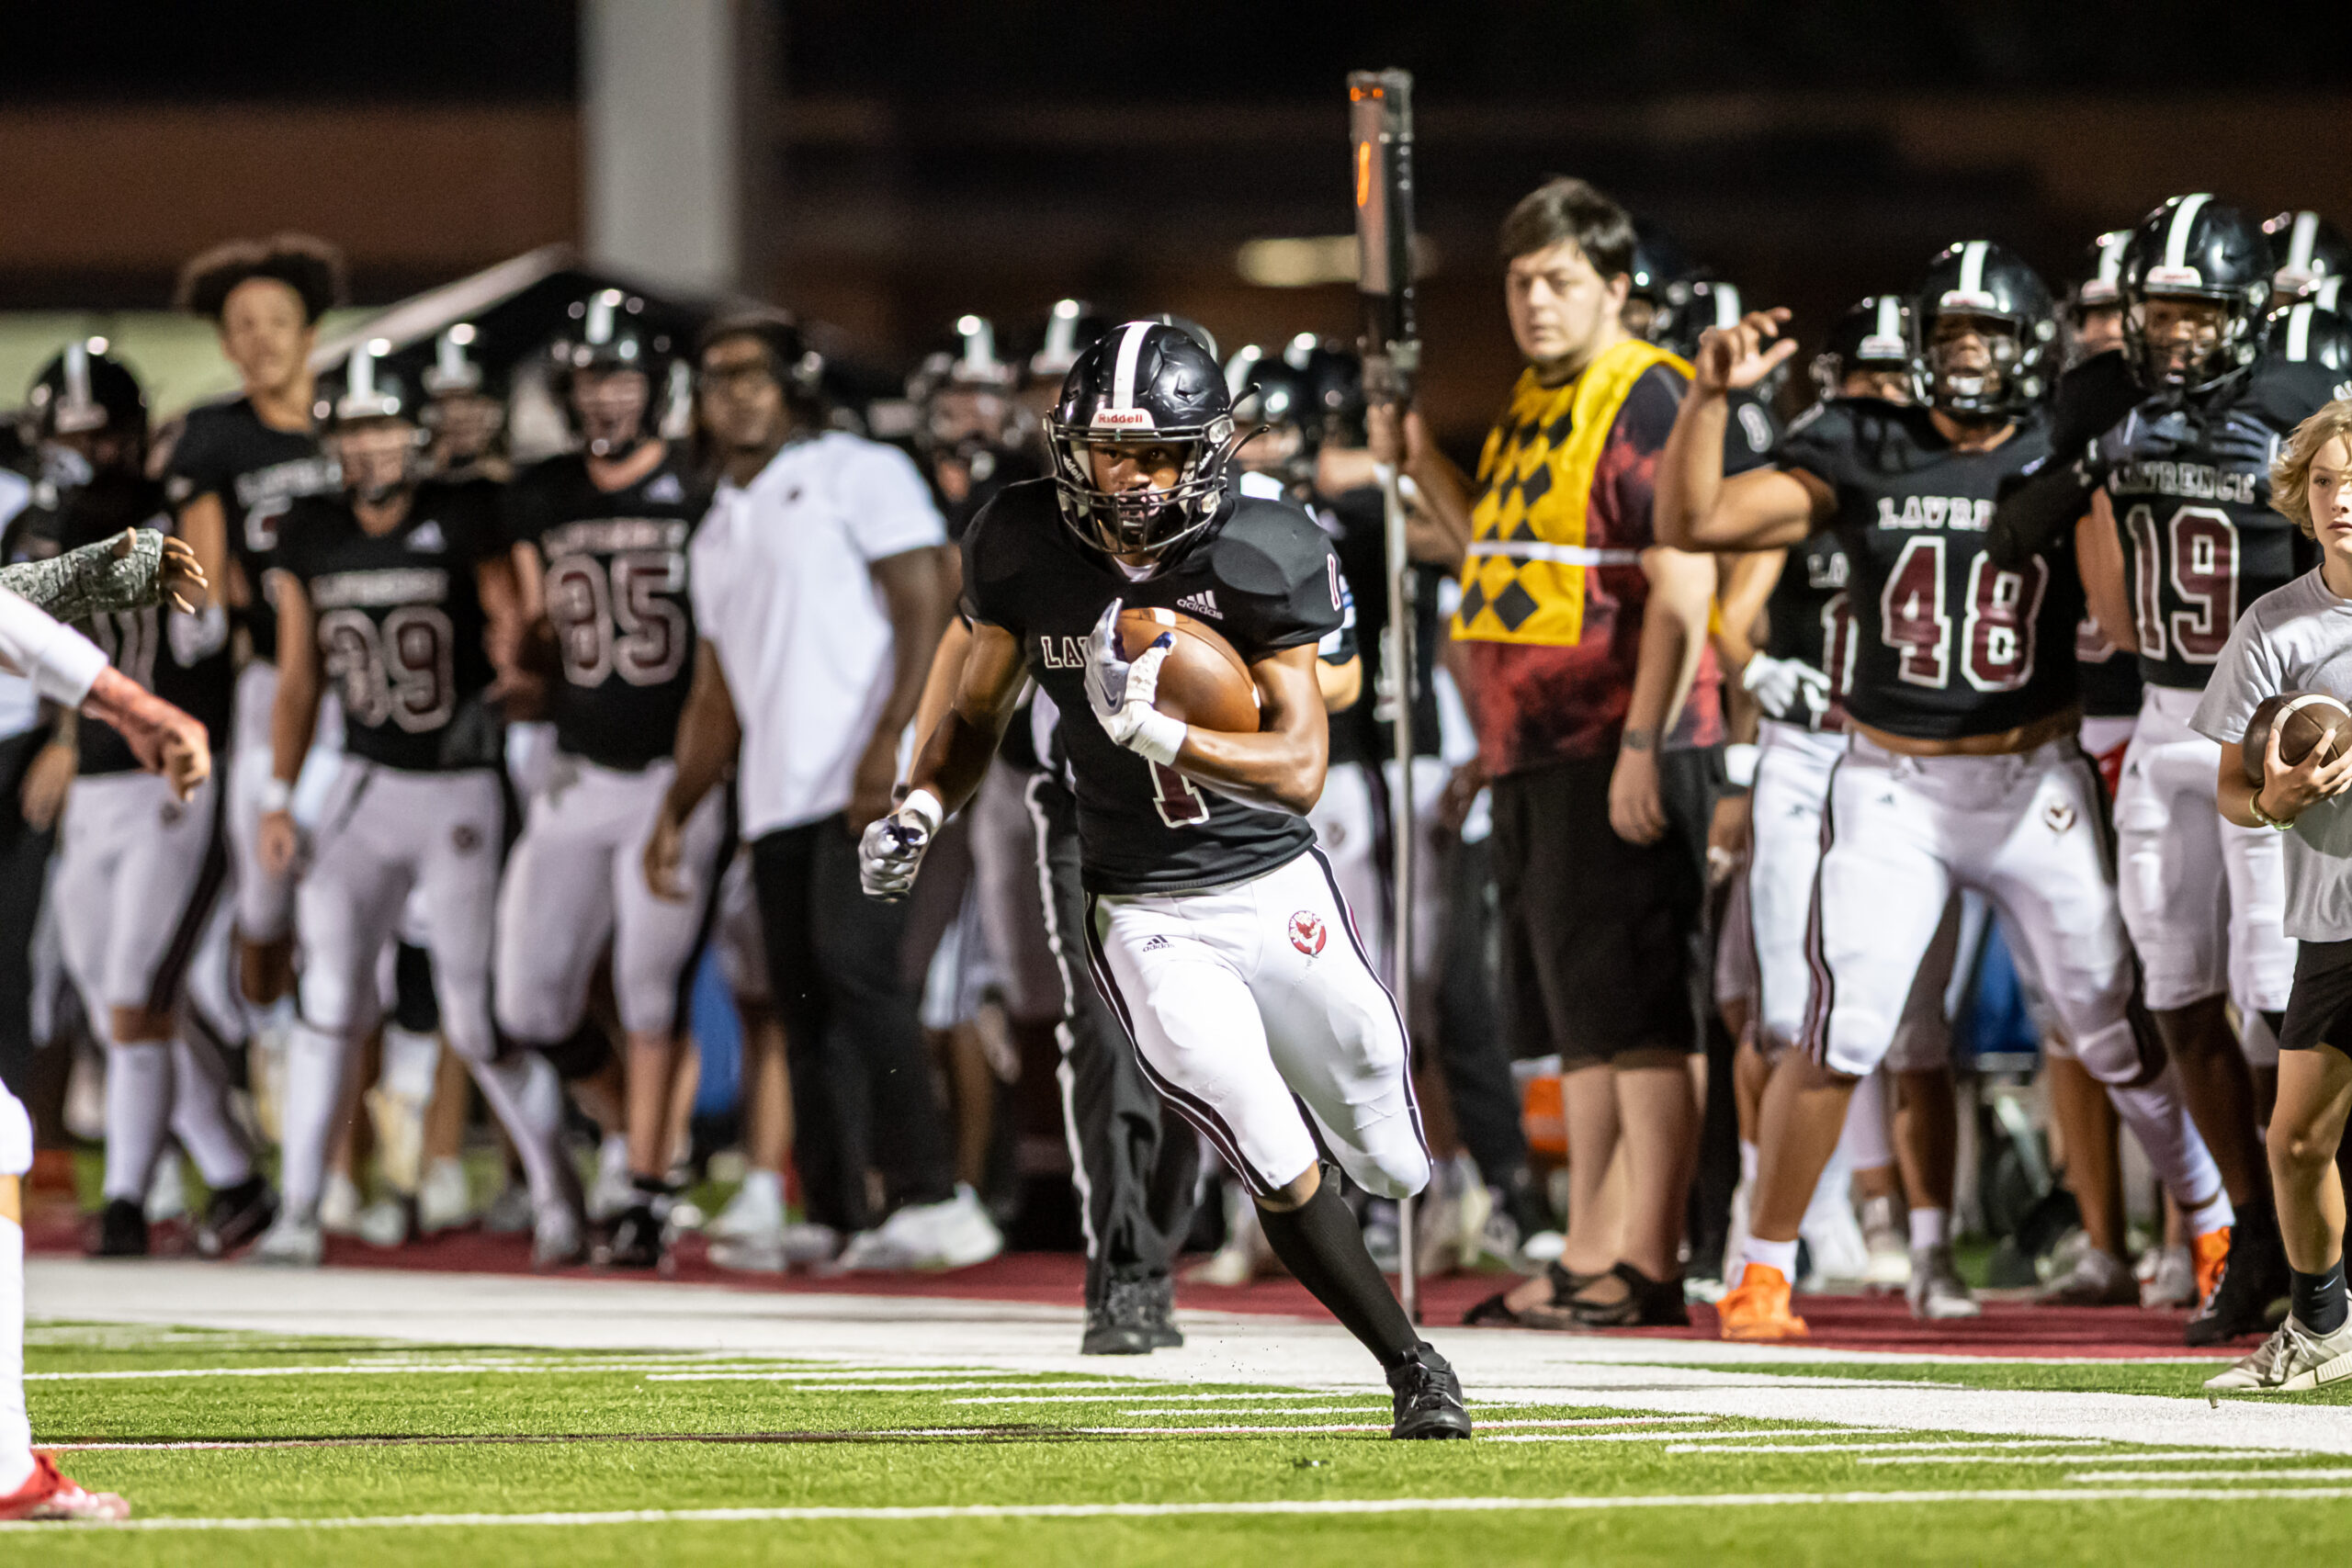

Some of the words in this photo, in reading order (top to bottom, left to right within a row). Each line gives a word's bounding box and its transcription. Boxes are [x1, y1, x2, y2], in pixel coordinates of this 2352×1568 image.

[1098, 414, 1143, 423] Riddell
[1327, 553, 1341, 612] 1
[2125, 503, 2239, 663] 19
[1176, 598, 1224, 620] adidas
[1881, 536, 2049, 692] 48
[1041, 636, 1091, 669] LA
[1142, 942, 1175, 953] adidas
